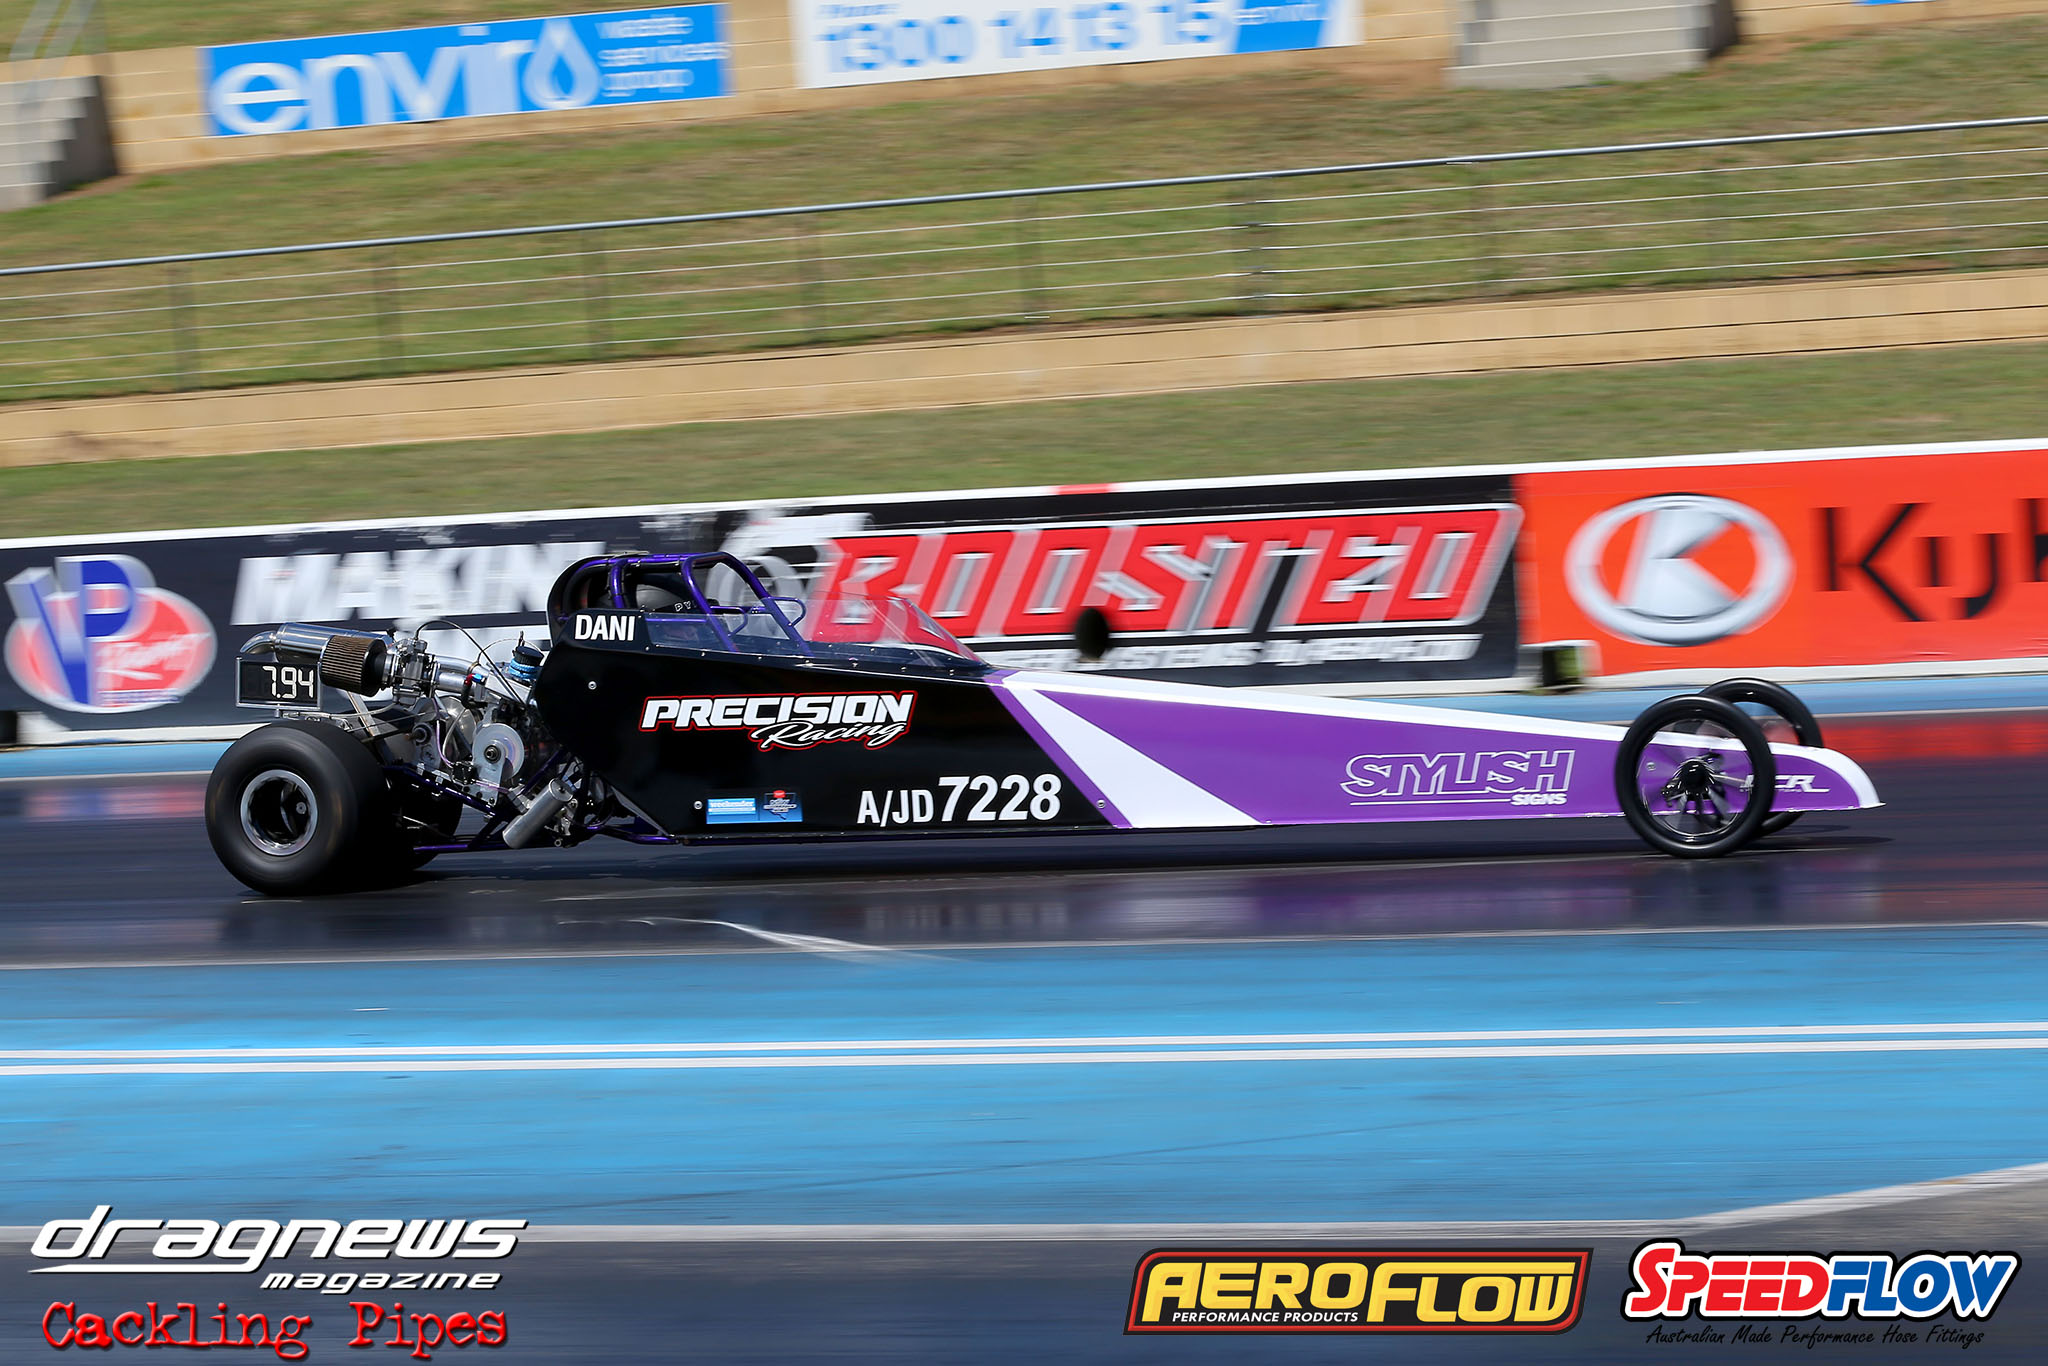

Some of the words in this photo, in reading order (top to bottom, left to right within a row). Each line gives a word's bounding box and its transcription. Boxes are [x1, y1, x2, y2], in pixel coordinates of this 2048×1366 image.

[815, 15, 976, 72] 1300
[985, 8, 1064, 58] 14
[1068, 2, 1142, 51] 13
[1150, 0, 1236, 46] 15
[806, 505, 1524, 646] BOOSTED
[575, 614, 635, 641] DANI
[262, 665, 314, 699] 7.94
[641, 694, 914, 729] PRECISION
[751, 721, 907, 749] Racing
[1340, 750, 1576, 797] STYLISH
[857, 789, 935, 827] A/JD
[938, 773, 1062, 822] 7228
[1510, 793, 1568, 806] SIGNS
